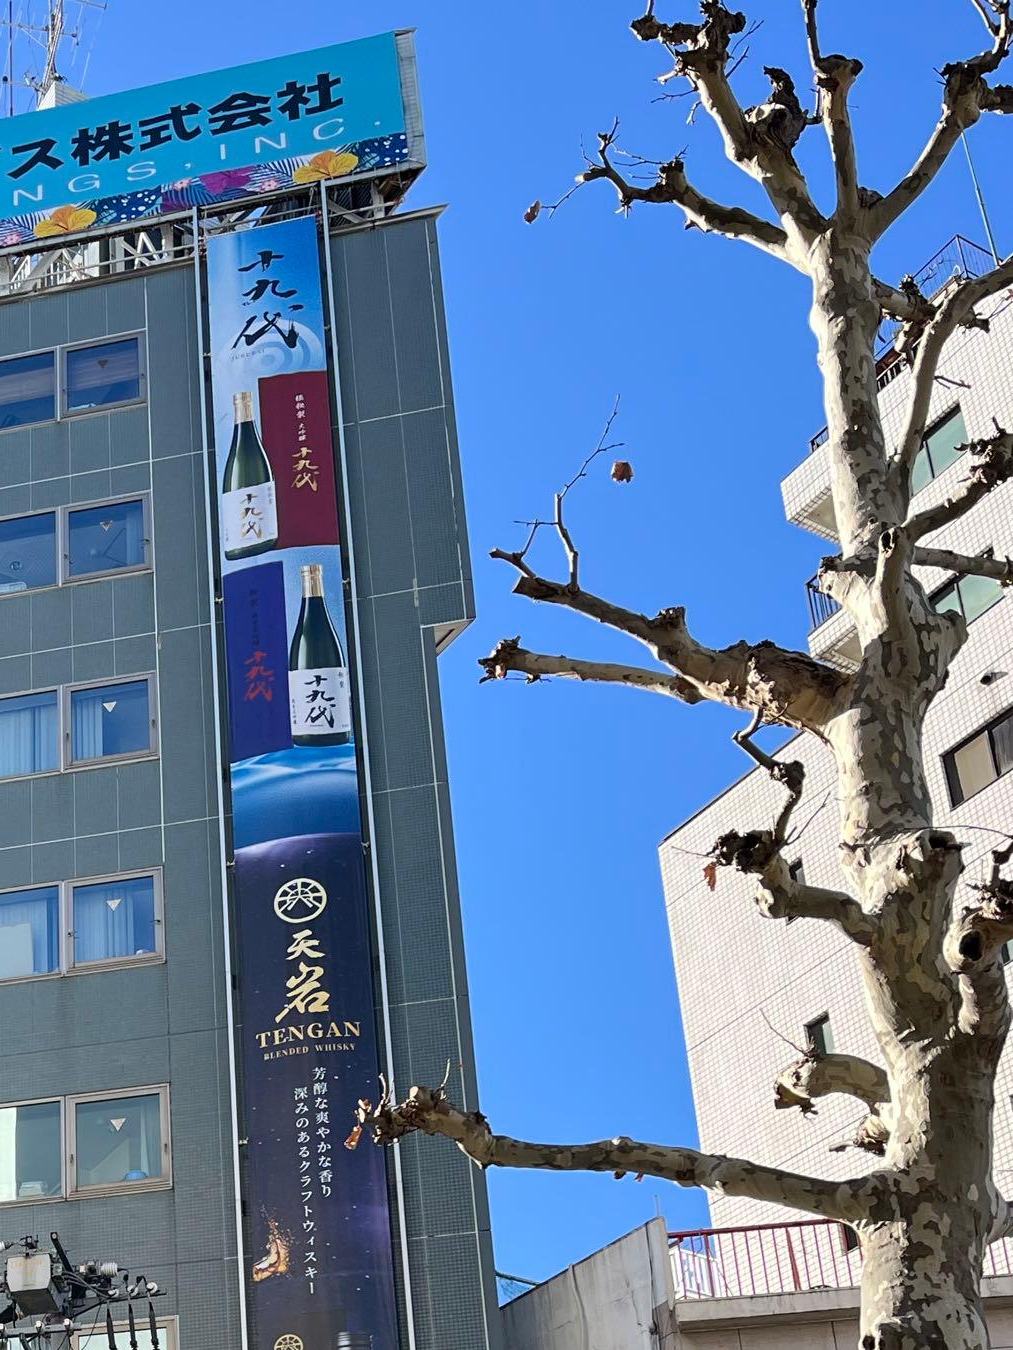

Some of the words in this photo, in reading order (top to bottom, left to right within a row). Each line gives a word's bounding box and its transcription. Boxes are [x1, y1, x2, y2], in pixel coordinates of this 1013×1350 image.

[232, 250, 304, 350] 十九代
[292, 447, 319, 491] 十九代
[304, 675, 336, 728] 十九代
[275, 929, 331, 1023] 天岩
[256, 1021, 362, 1049] TENGAN
[264, 1045, 309, 1061] BLENDED
[315, 1042, 356, 1052] WHISKY
[313, 1066, 333, 1198] 芳醇な爽やかな香り
[294, 1087, 319, 1294] 深みのあるクラフトウィスキー
